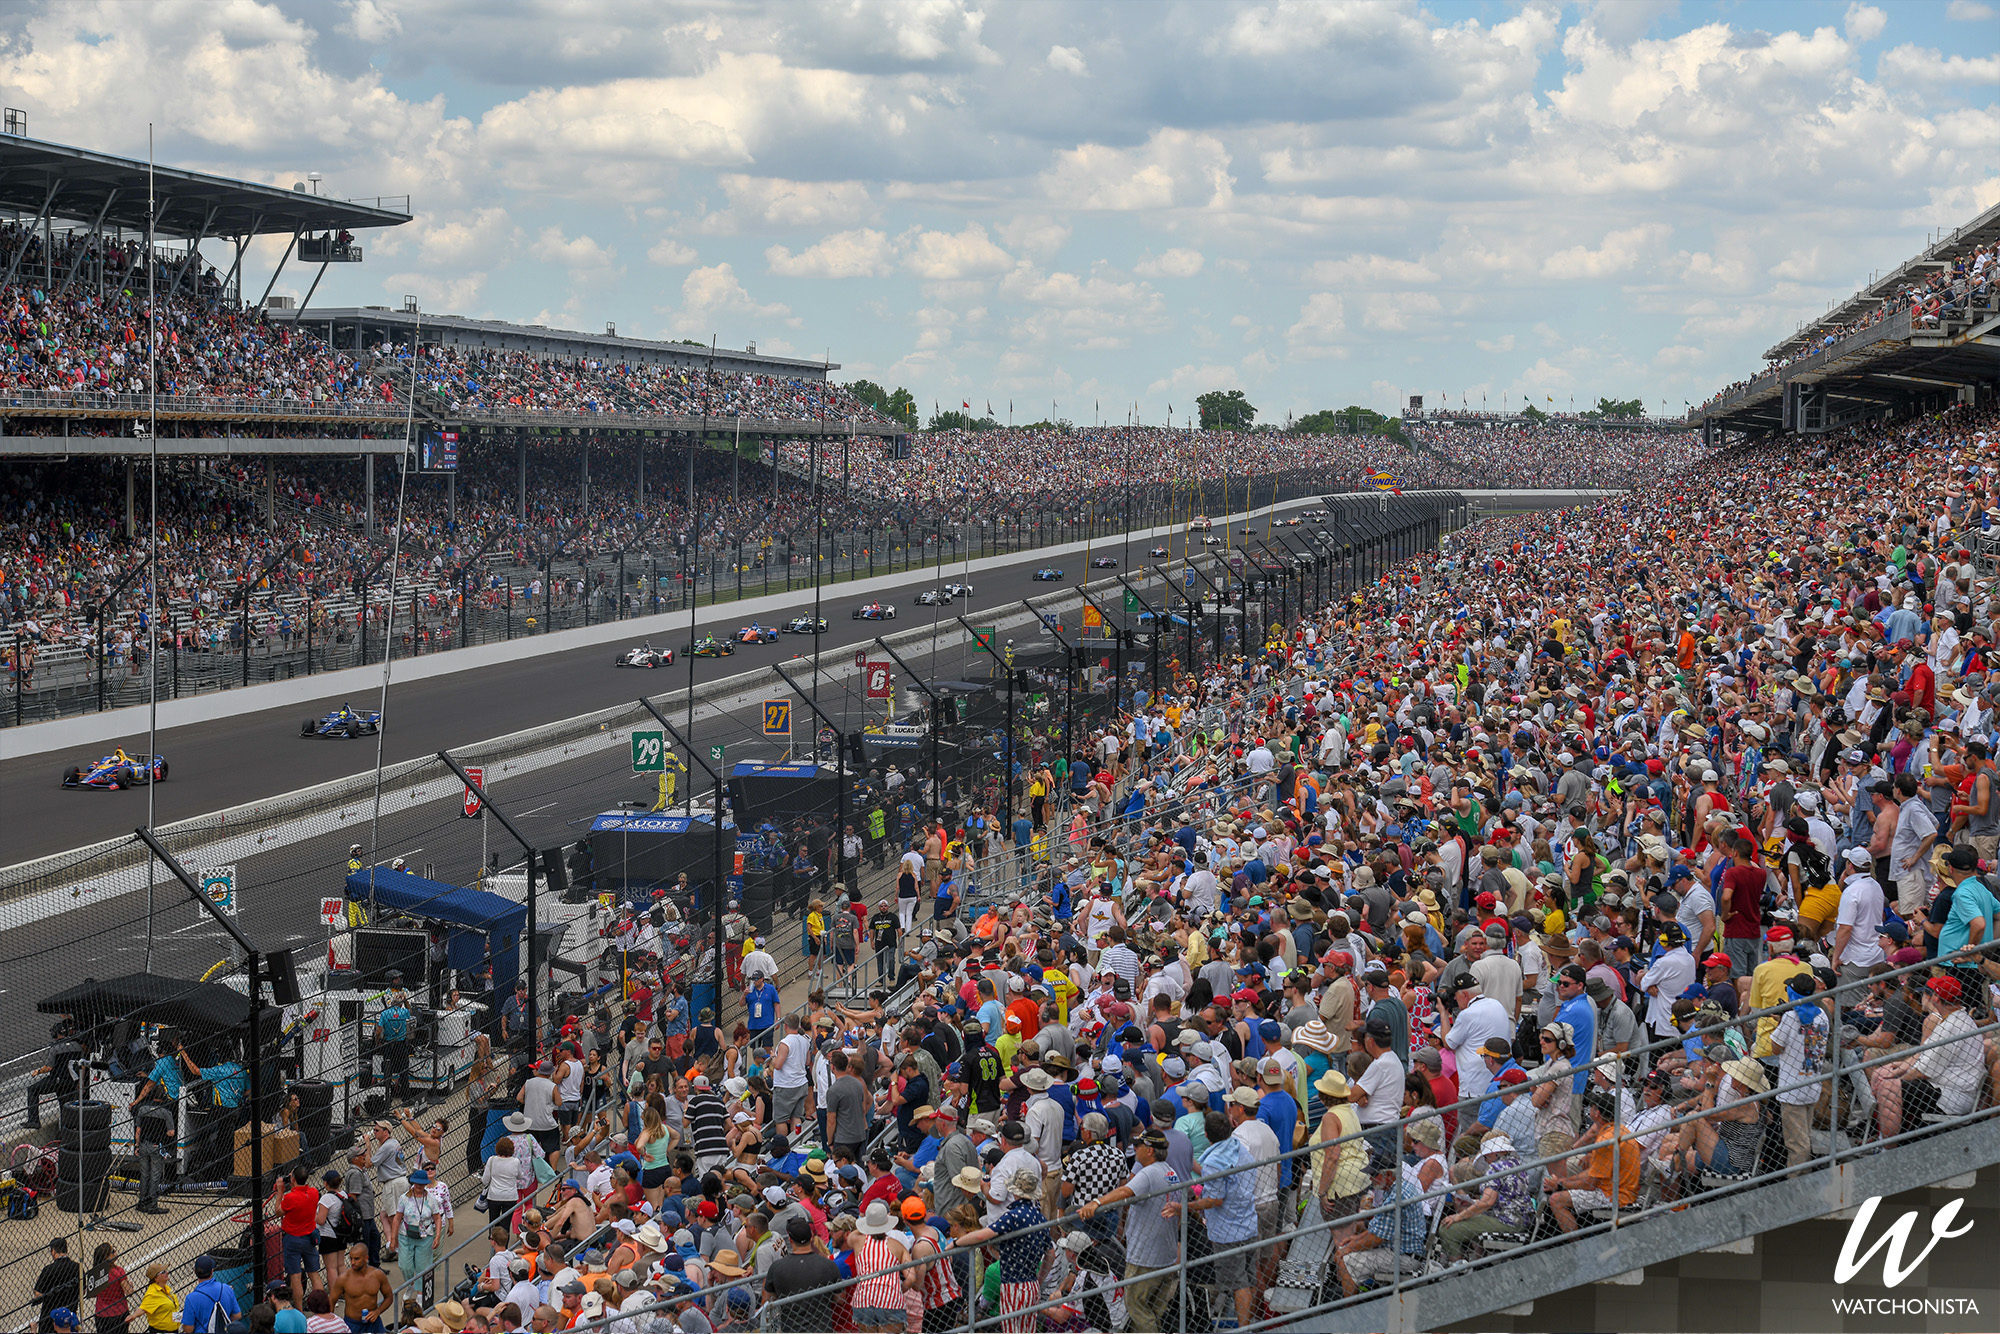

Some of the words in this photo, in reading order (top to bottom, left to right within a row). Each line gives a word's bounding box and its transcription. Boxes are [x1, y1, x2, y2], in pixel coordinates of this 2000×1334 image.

[1365, 478, 1403, 486] SUNOCO
[1087, 609, 1100, 623] 26
[870, 669, 887, 691] 6
[766, 705, 788, 729] 27
[637, 738, 661, 765] 29
[712, 746, 721, 759] 29
[979, 1057, 998, 1081] 83
